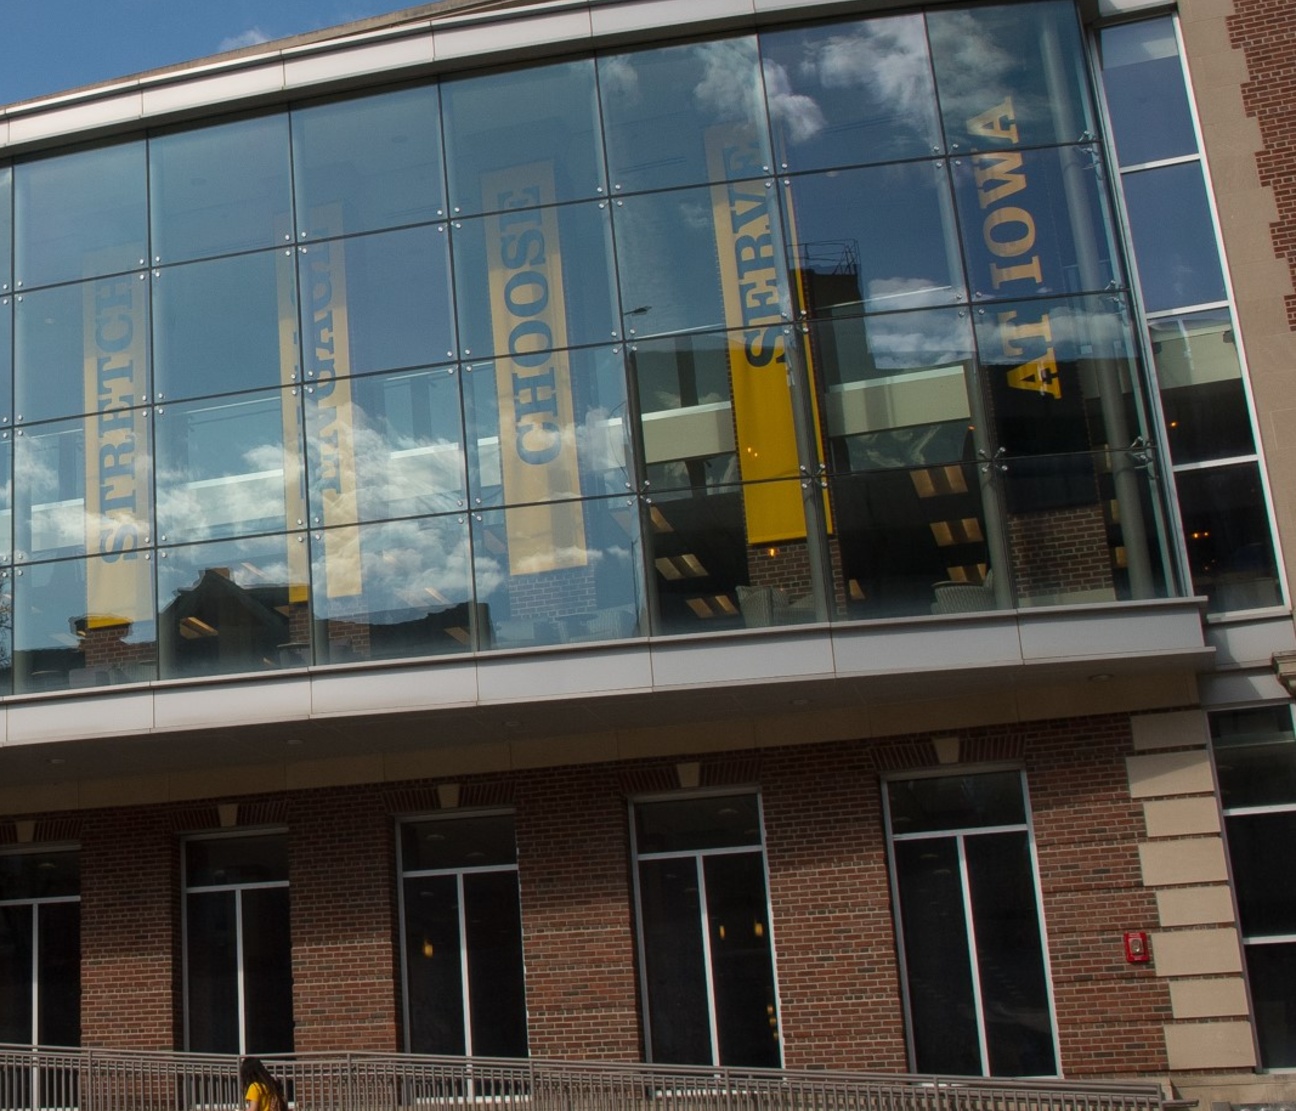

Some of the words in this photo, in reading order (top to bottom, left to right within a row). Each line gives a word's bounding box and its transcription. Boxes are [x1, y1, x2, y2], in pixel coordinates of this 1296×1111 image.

[723, 142, 788, 367] SERVE
[967, 95, 1043, 290] IOWA
[498, 186, 562, 465] CHOOSE
[1003, 311, 1062, 399] AT
